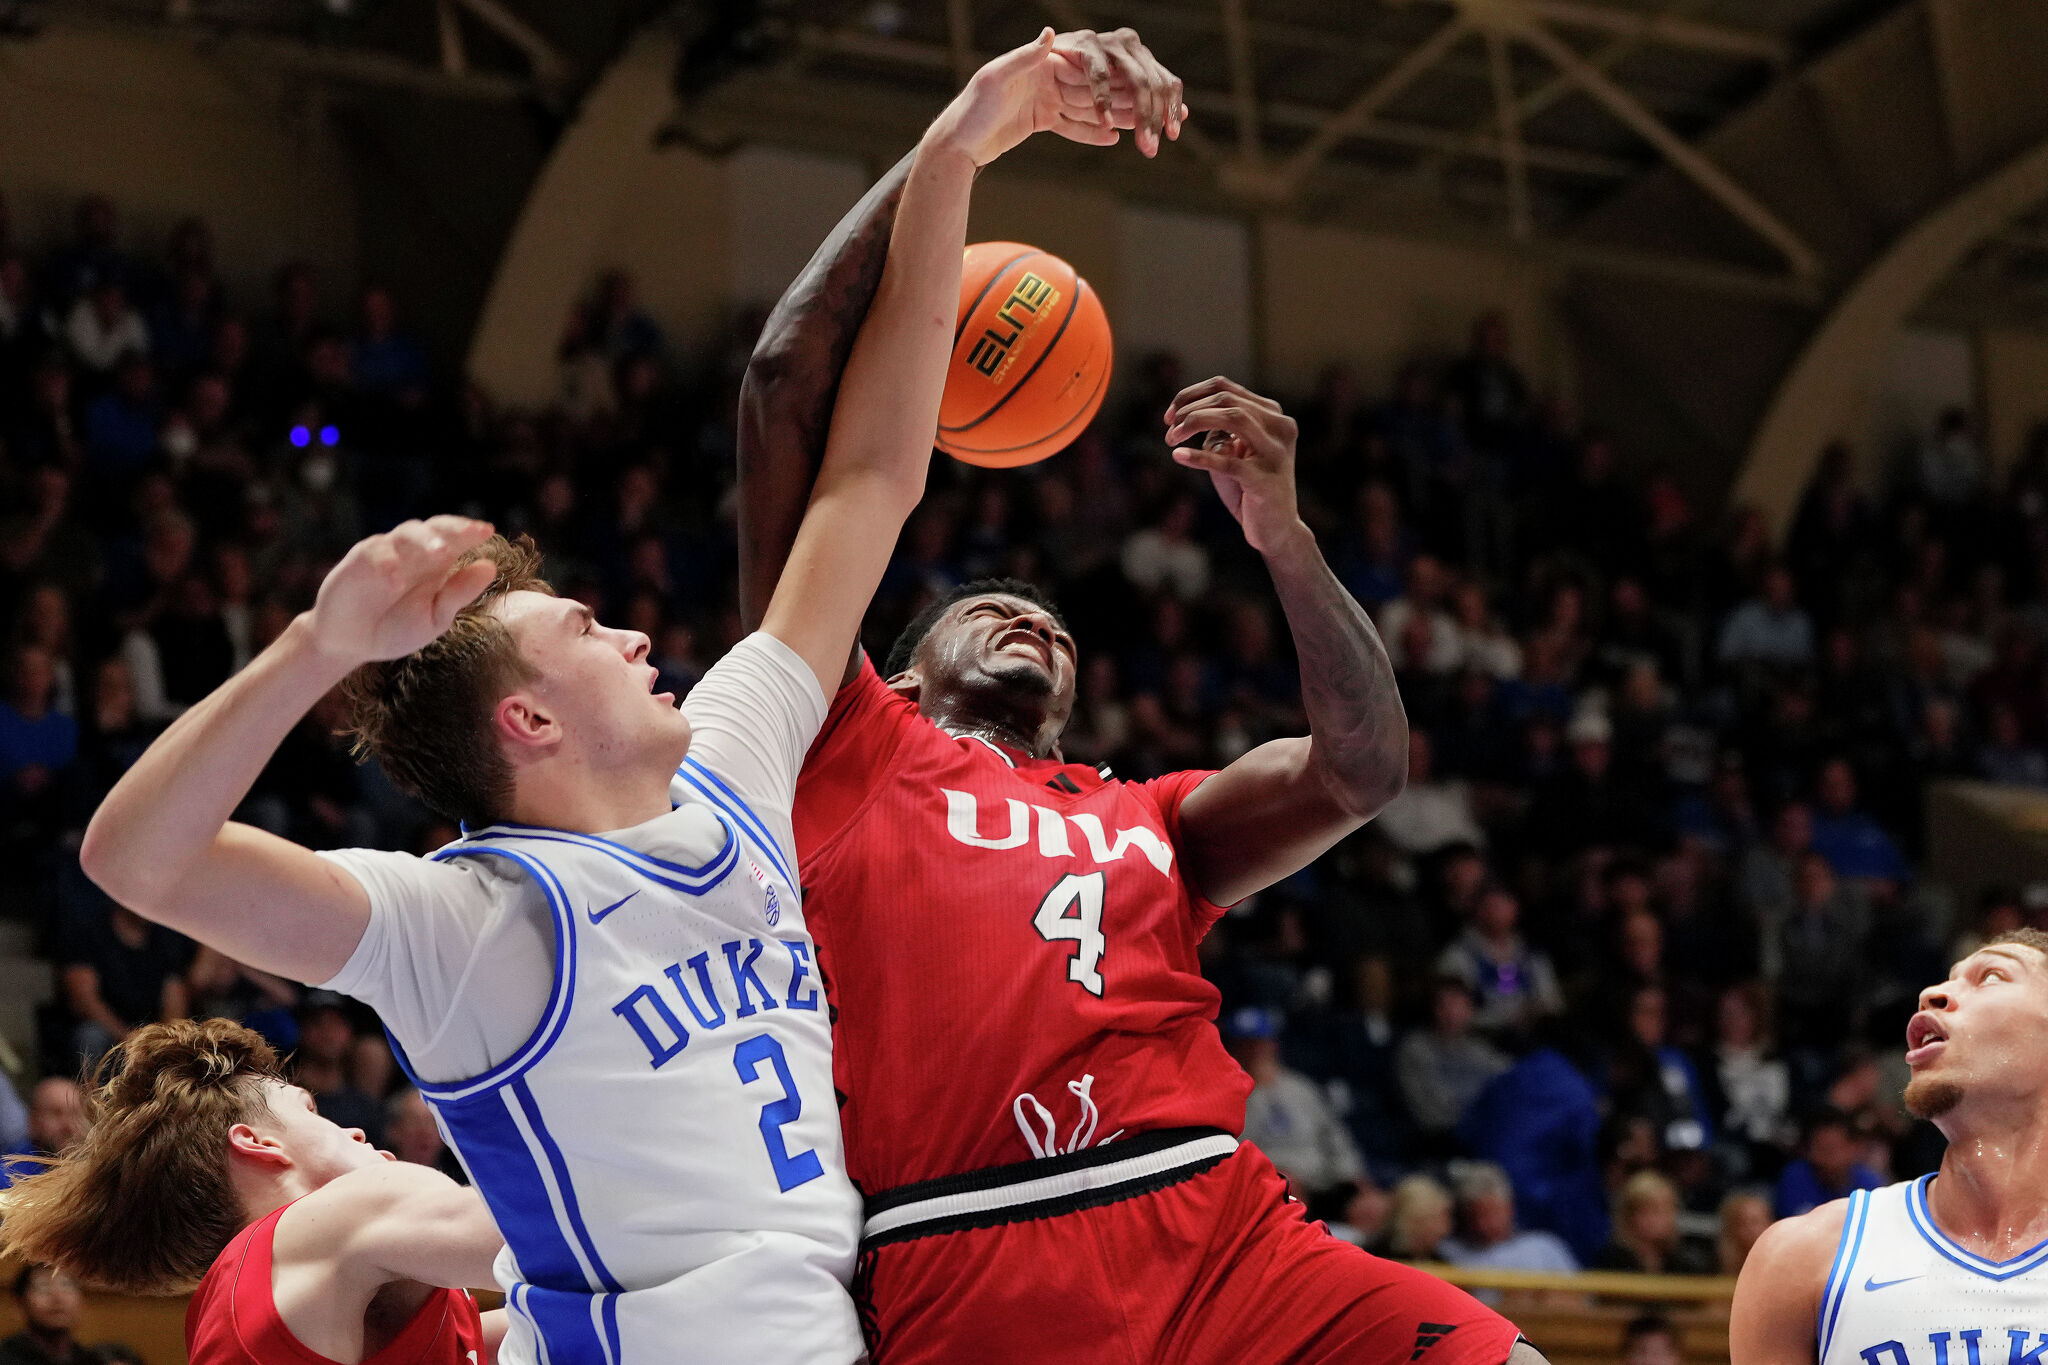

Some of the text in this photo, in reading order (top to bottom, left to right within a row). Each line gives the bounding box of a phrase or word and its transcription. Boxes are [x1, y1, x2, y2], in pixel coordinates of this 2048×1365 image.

[964, 271, 1055, 378] ELITE
[940, 787, 1174, 881] UIW
[1030, 870, 1106, 1000] 4
[612, 938, 818, 1070] DUKE
[733, 1033, 825, 1193] 2
